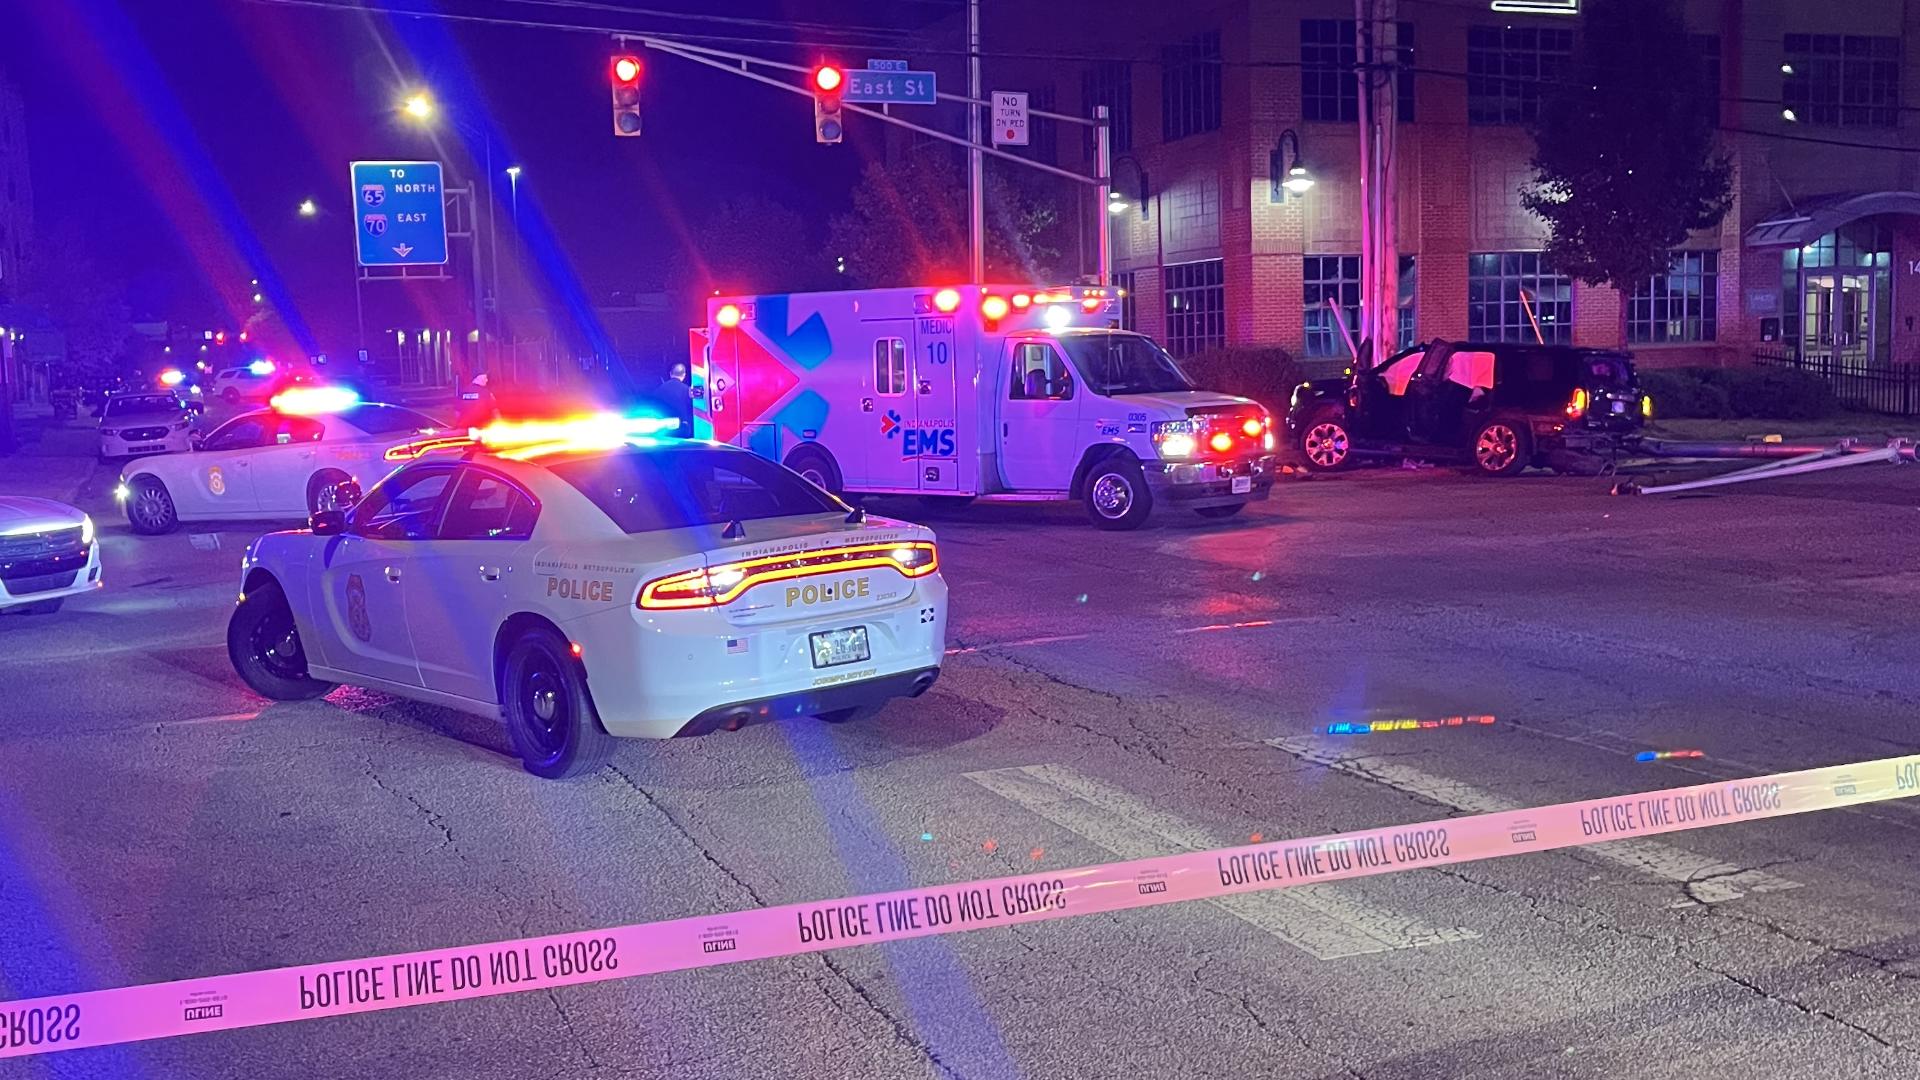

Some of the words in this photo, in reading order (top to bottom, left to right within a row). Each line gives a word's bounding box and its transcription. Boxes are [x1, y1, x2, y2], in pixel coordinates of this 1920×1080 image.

[874, 62, 892, 70] 500
[895, 63, 902, 71] E
[850, 79, 894, 95] East
[905, 80, 925, 96] St
[1002, 97, 1018, 107] NO
[1000, 108, 1021, 117] TURN
[996, 118, 1008, 127] ON
[1010, 119, 1025, 128] RED
[389, 169, 405, 178] TO
[395, 184, 436, 193] NORTH
[364, 190, 384, 203] 65
[397, 213, 427, 222] EAST
[366, 220, 386, 233] 70
[920, 320, 952, 334] MEDIC
[926, 341, 948, 364] 10
[904, 419, 955, 428] INDIANAPOLIS
[1102, 426, 1120, 435] EMS
[902, 429, 955, 457] EMS
[741, 542, 808, 557] INDIANAPOLIS
[844, 533, 899, 544] METROPOLITAN
[535, 560, 578, 570] INDIANAPOLIS
[583, 564, 636, 574] METROPOLITAN
[547, 577, 614, 601] POLICE
[786, 577, 870, 607] POLICE
